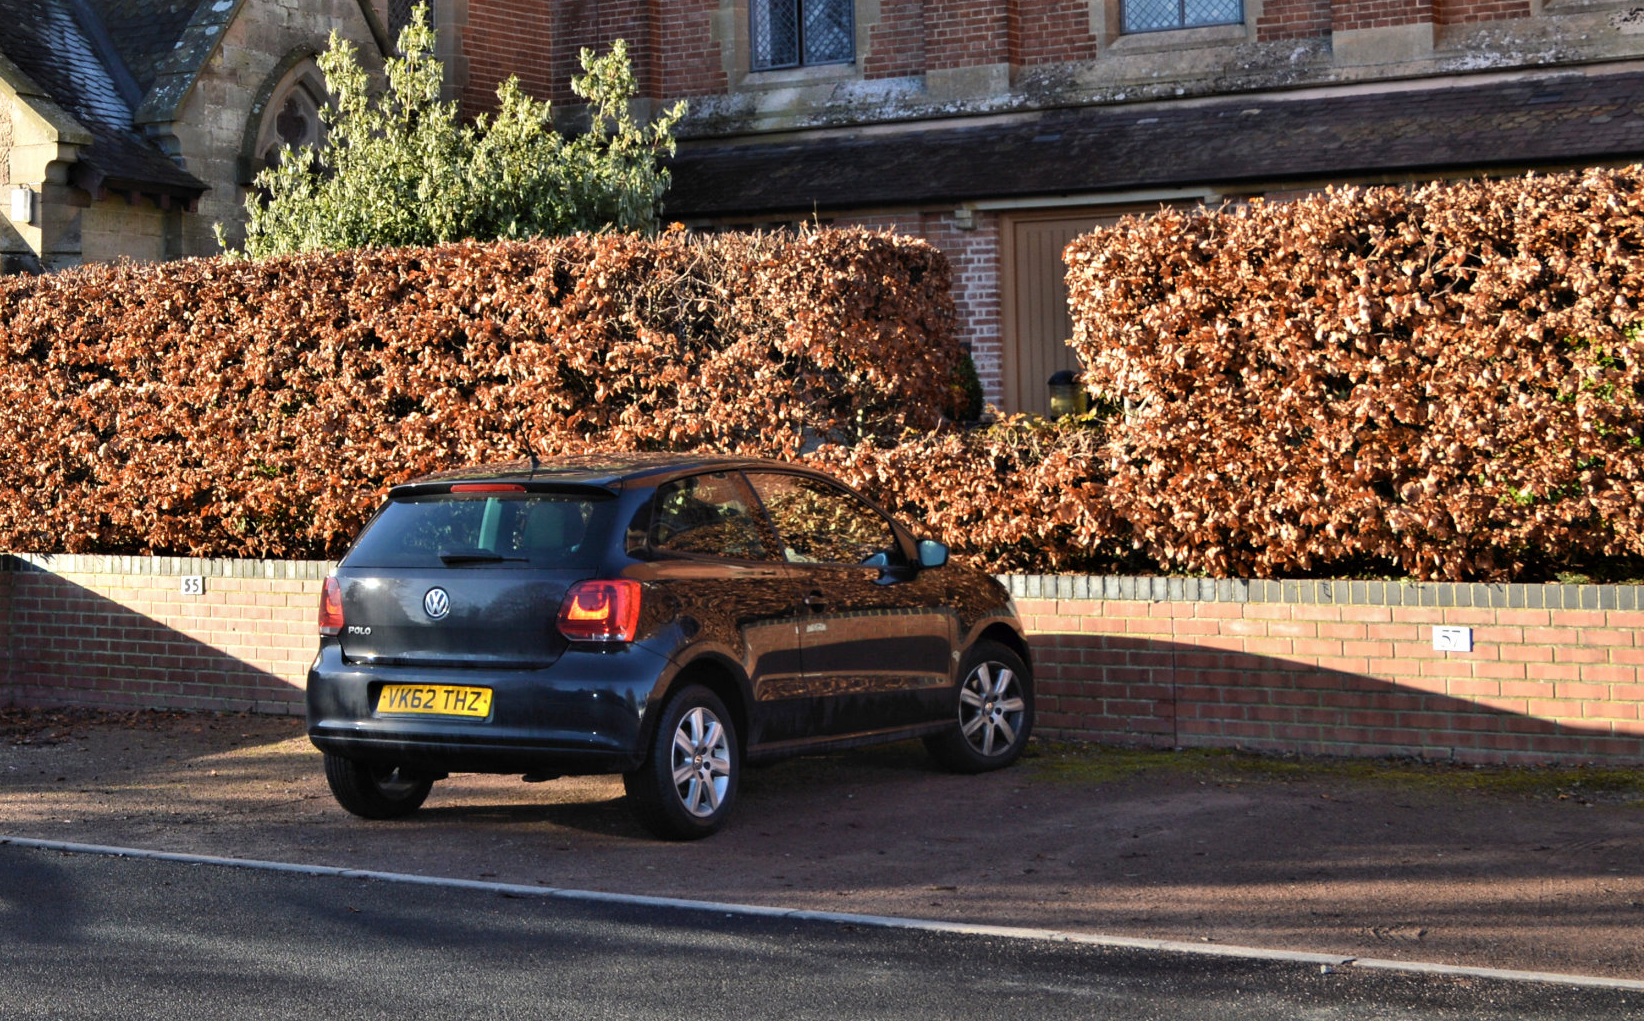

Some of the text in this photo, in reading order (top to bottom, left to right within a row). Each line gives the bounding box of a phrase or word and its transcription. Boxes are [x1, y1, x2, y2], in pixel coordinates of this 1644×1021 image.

[348, 626, 372, 635] POLO
[388, 688, 482, 711] VK62 THZ
